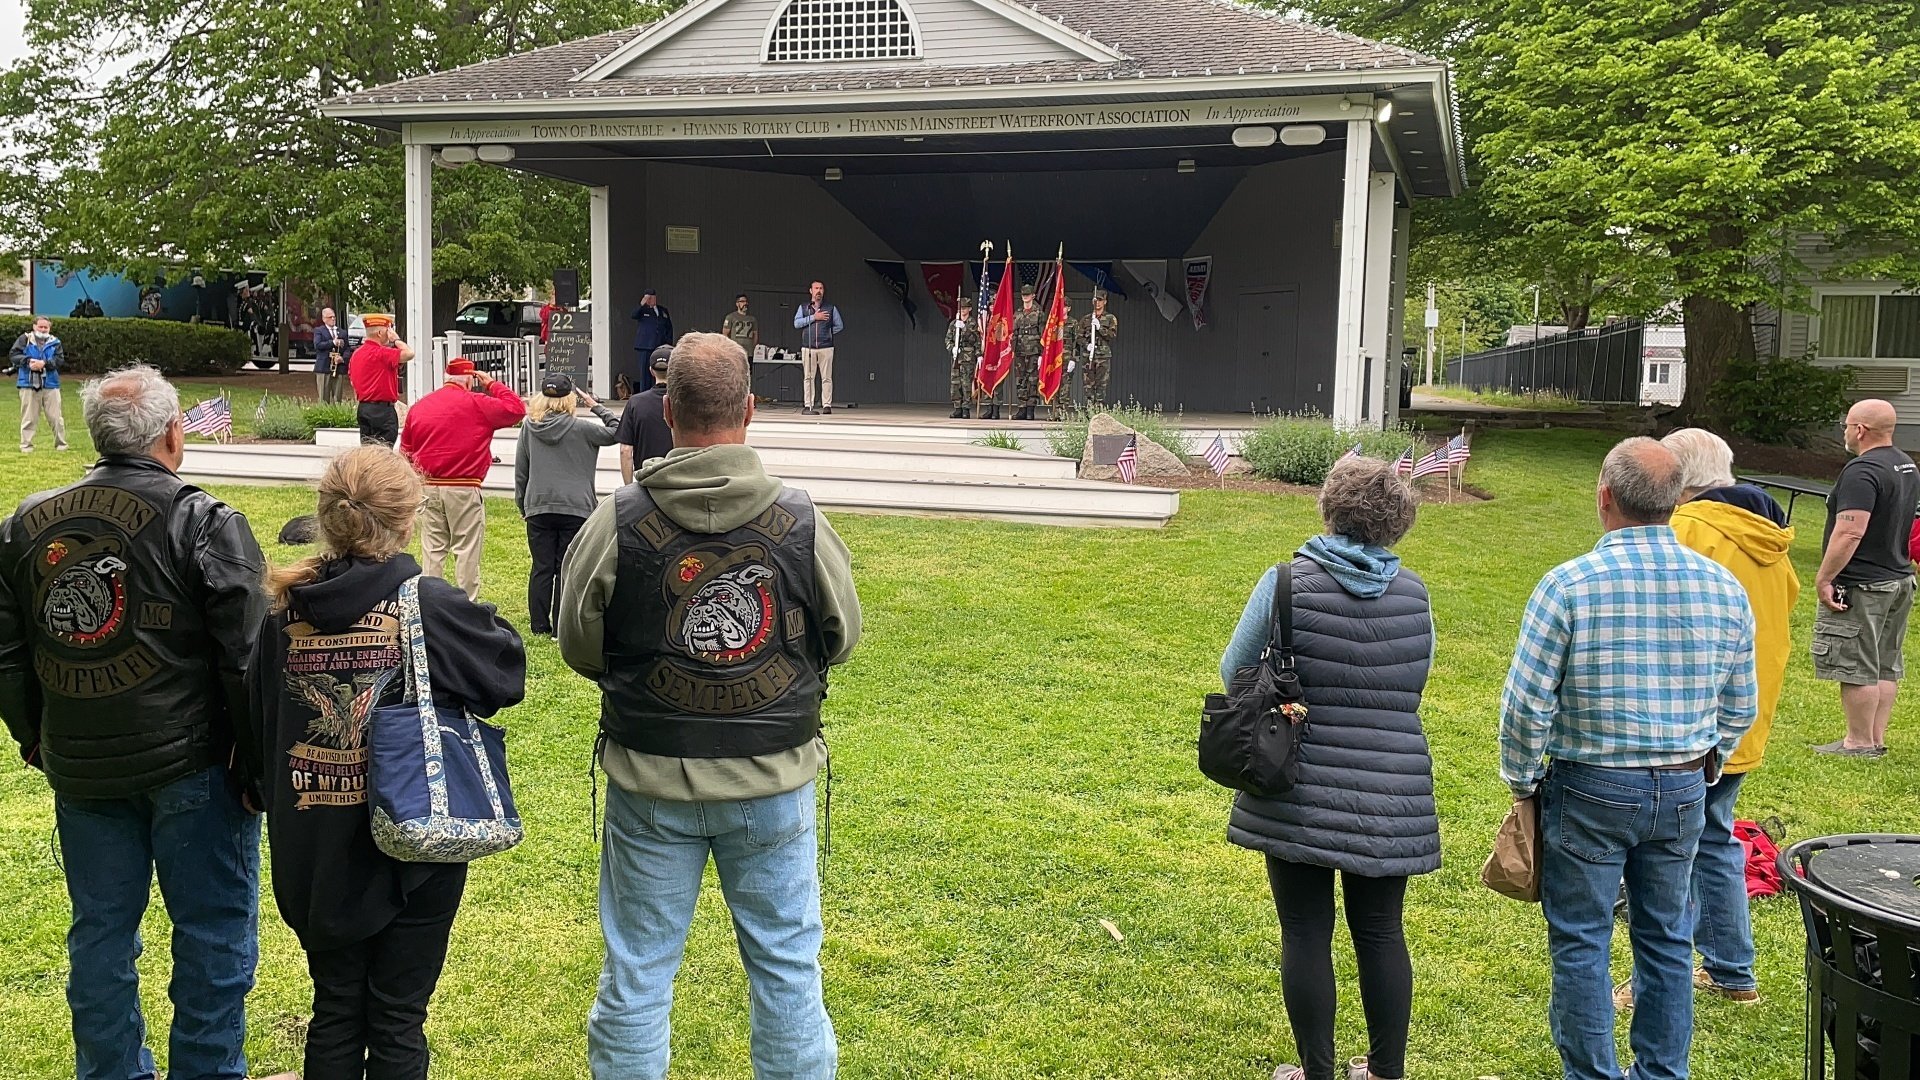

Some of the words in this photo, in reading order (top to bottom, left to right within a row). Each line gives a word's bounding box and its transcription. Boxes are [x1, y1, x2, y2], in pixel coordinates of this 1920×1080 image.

[1206, 106, 1219, 120] In
[1222, 103, 1300, 122] Appreciation
[531, 125, 567, 138] TOWN
[590, 123, 664, 138] BARNSTABLE
[683, 122, 738, 136] HYANNIS
[743, 121, 792, 135] ROTARY
[795, 120, 830, 134] CLUB
[849, 118, 907, 133] HYANNIS
[910, 115, 997, 131] MAINSTREET
[999, 112, 1095, 129] WATERFRONT
[1096, 108, 1191, 125] ASSOCIATION
[450, 127, 460, 139] In
[463, 126, 520, 142] Appreciation
[551, 313, 573, 330] 22
[29, 488, 151, 534] JARHEADS
[142, 603, 171, 627] MC
[786, 612, 804, 637] MC
[295, 639, 314, 648] THE
[318, 635, 392, 647] CONSTITUTION
[287, 652, 331, 664] AGAINST
[332, 651, 354, 662] ALL
[356, 650, 401, 660] ENEMIES
[288, 662, 327, 672] FOREIGN
[329, 661, 350, 671] AND
[35, 652, 128, 694] SEMPER
[129, 649, 157, 680] FI
[650, 664, 768, 711] SEMPER
[763, 656, 794, 693] FI
[306, 748, 315, 758] BE
[289, 756, 310, 771] HAS
[312, 762, 335, 775] EVER
[292, 770, 313, 790] OF
[318, 774, 338, 791] MY
[334, 793, 358, 803] THIS
